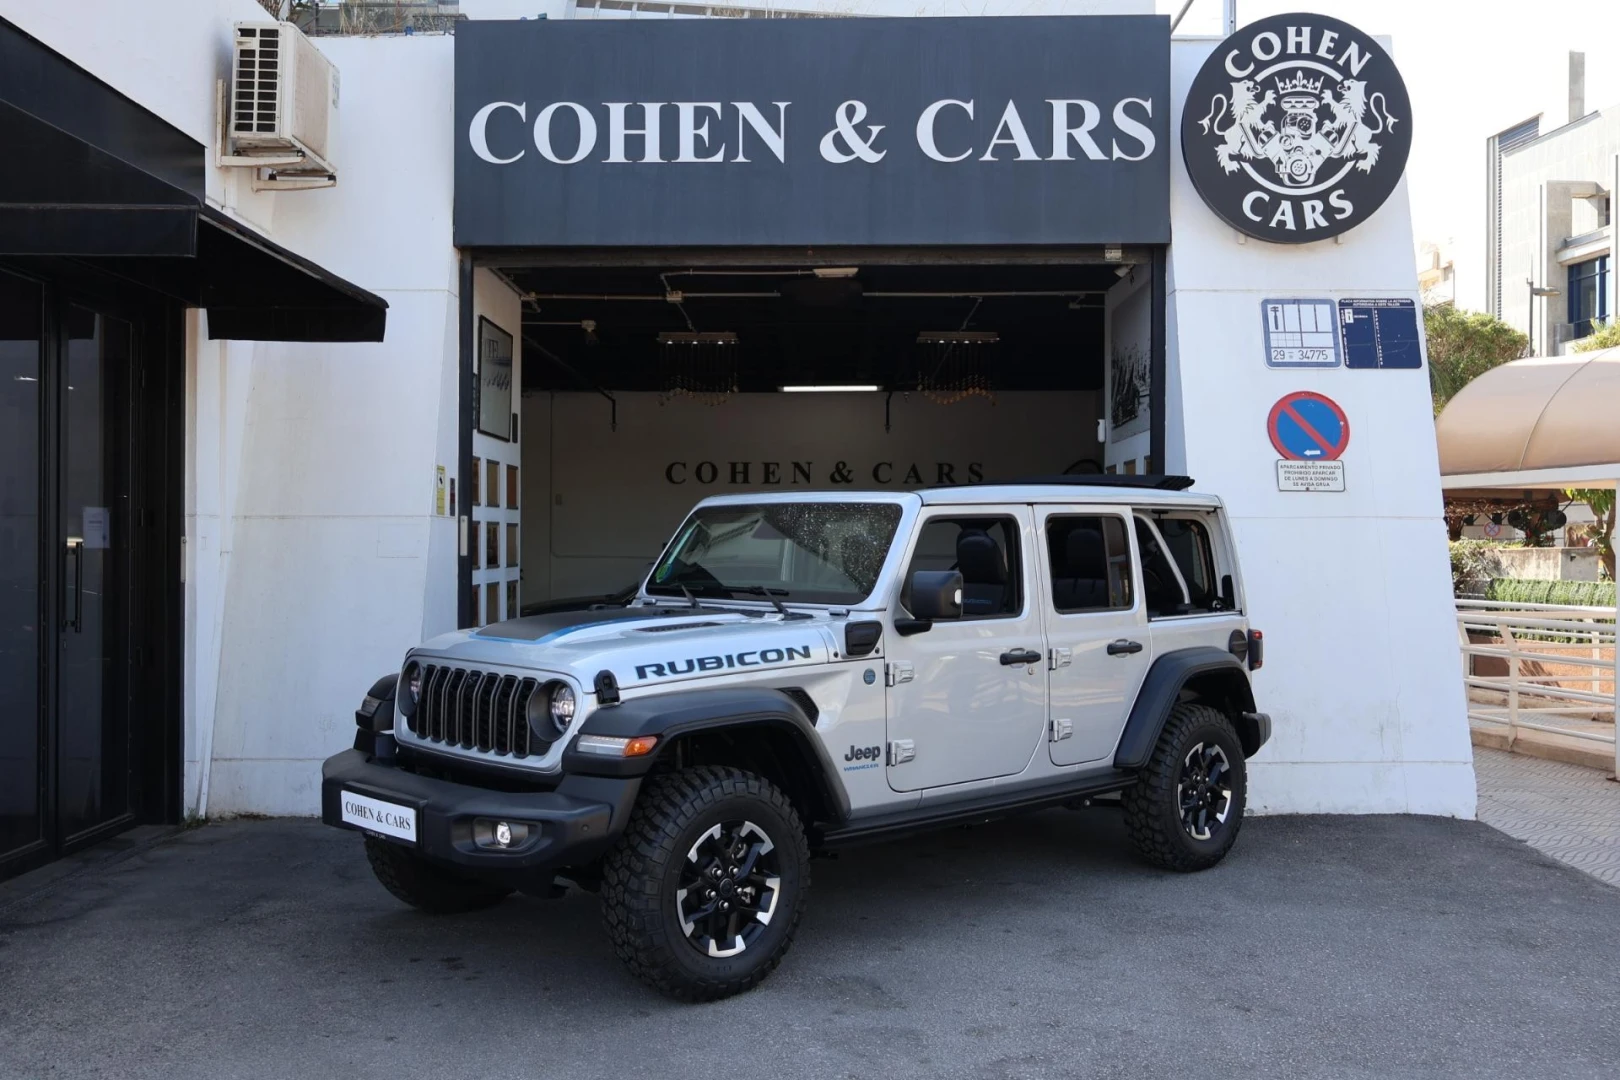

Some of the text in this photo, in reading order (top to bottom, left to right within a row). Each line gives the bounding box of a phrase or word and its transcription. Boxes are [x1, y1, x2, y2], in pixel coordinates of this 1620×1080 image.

[1225, 26, 1372, 78] COHEN
[468, 97, 1157, 164] COHEN & CARS
[1242, 189, 1353, 230] CARS
[1273, 350, 1285, 360] 29
[1298, 350, 1328, 360] 34775
[665, 461, 984, 485] COHEN & CARS
[635, 645, 811, 680] RUBICON
[844, 745, 881, 762] Jeep
[345, 801, 411, 830] COHEN & CARS
